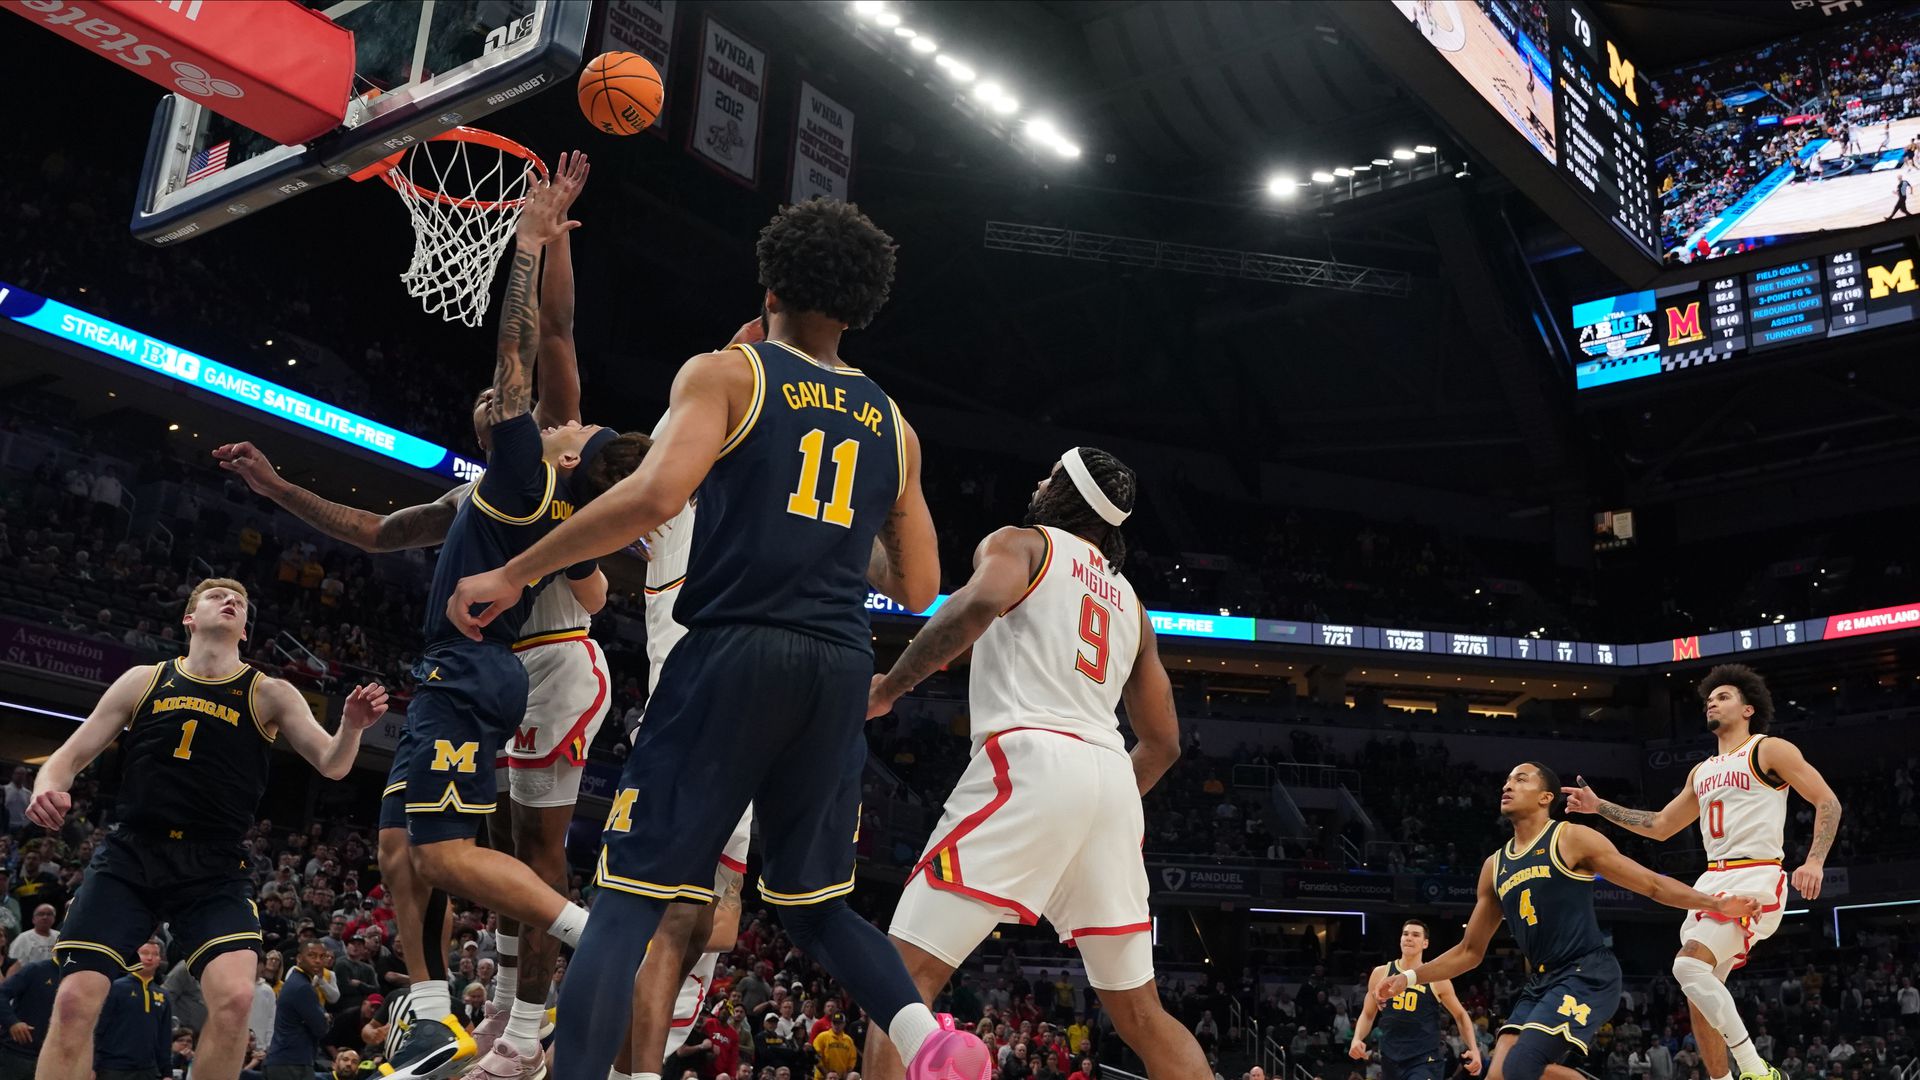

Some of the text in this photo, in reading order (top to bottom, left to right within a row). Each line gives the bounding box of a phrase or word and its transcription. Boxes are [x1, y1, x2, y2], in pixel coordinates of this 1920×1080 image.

[1571, 8, 1591, 47] 79
[714, 33, 755, 75] WNBA
[708, 55, 760, 103] CHAMPIONS
[715, 90, 745, 122] 2012
[811, 97, 844, 130] WNBA
[809, 168, 834, 193] 2015
[1833, 252, 1852, 264] 46.2
[1756, 263, 1809, 282] FIELD GOAL %
[1834, 265, 1854, 277] 92.3
[1867, 258, 1919, 300] M
[1714, 279, 1734, 291] 44.3
[1755, 275, 1813, 294] FREE THROW %
[1759, 287, 1812, 305] 3-POINT FG %
[1832, 291, 1844, 302] 47
[1716, 303, 1736, 315] 33.3
[1753, 298, 1820, 319] REBOUNDS (OFF)
[1843, 302, 1854, 313] 17
[1666, 302, 1702, 341] M
[1727, 315, 1739, 326] (4)
[1771, 314, 1805, 328] ASSISTS
[1722, 328, 1734, 339] 17
[1764, 325, 1813, 341] TURNOVERS
[60, 314, 137, 355] STREAM
[204, 367, 261, 401] GAMES
[263, 388, 396, 451] SATELLITE-FREE
[781, 381, 884, 438] GAYLE JR.
[453, 457, 487, 482] DIR
[786, 427, 861, 530] 11
[1071, 558, 1124, 612] MIGUEL
[864, 593, 905, 611] ECT
[1837, 609, 1920, 632] #2 MARYLAND
[12, 627, 104, 661] Ascension
[1075, 593, 1110, 684] 9
[1323, 632, 1352, 646] 7/21
[1387, 637, 1424, 650] 19/23
[1742, 637, 1752, 649] 0
[1786, 631, 1796, 643] 8
[1453, 642, 1488, 655] 27/61
[1519, 646, 1529, 658] 7
[1558, 649, 1572, 661] 17
[1598, 651, 1613, 663] 18
[1672, 636, 1701, 661] M
[6, 646, 104, 680] St. Vincent
[152, 696, 240, 727] MICHIGAN
[173, 719, 198, 760] 1
[514, 726, 538, 751] M
[430, 739, 480, 773] M
[1708, 799, 1725, 839] 0
[1190, 871, 1244, 884] FANDUEL
[1299, 880, 1392, 894] Fanatics Sportsbook
[1497, 865, 1552, 901] MICHIGAN
[1519, 888, 1538, 926] 4
[1392, 991, 1418, 1012] 50
[1557, 994, 1592, 1027] M
